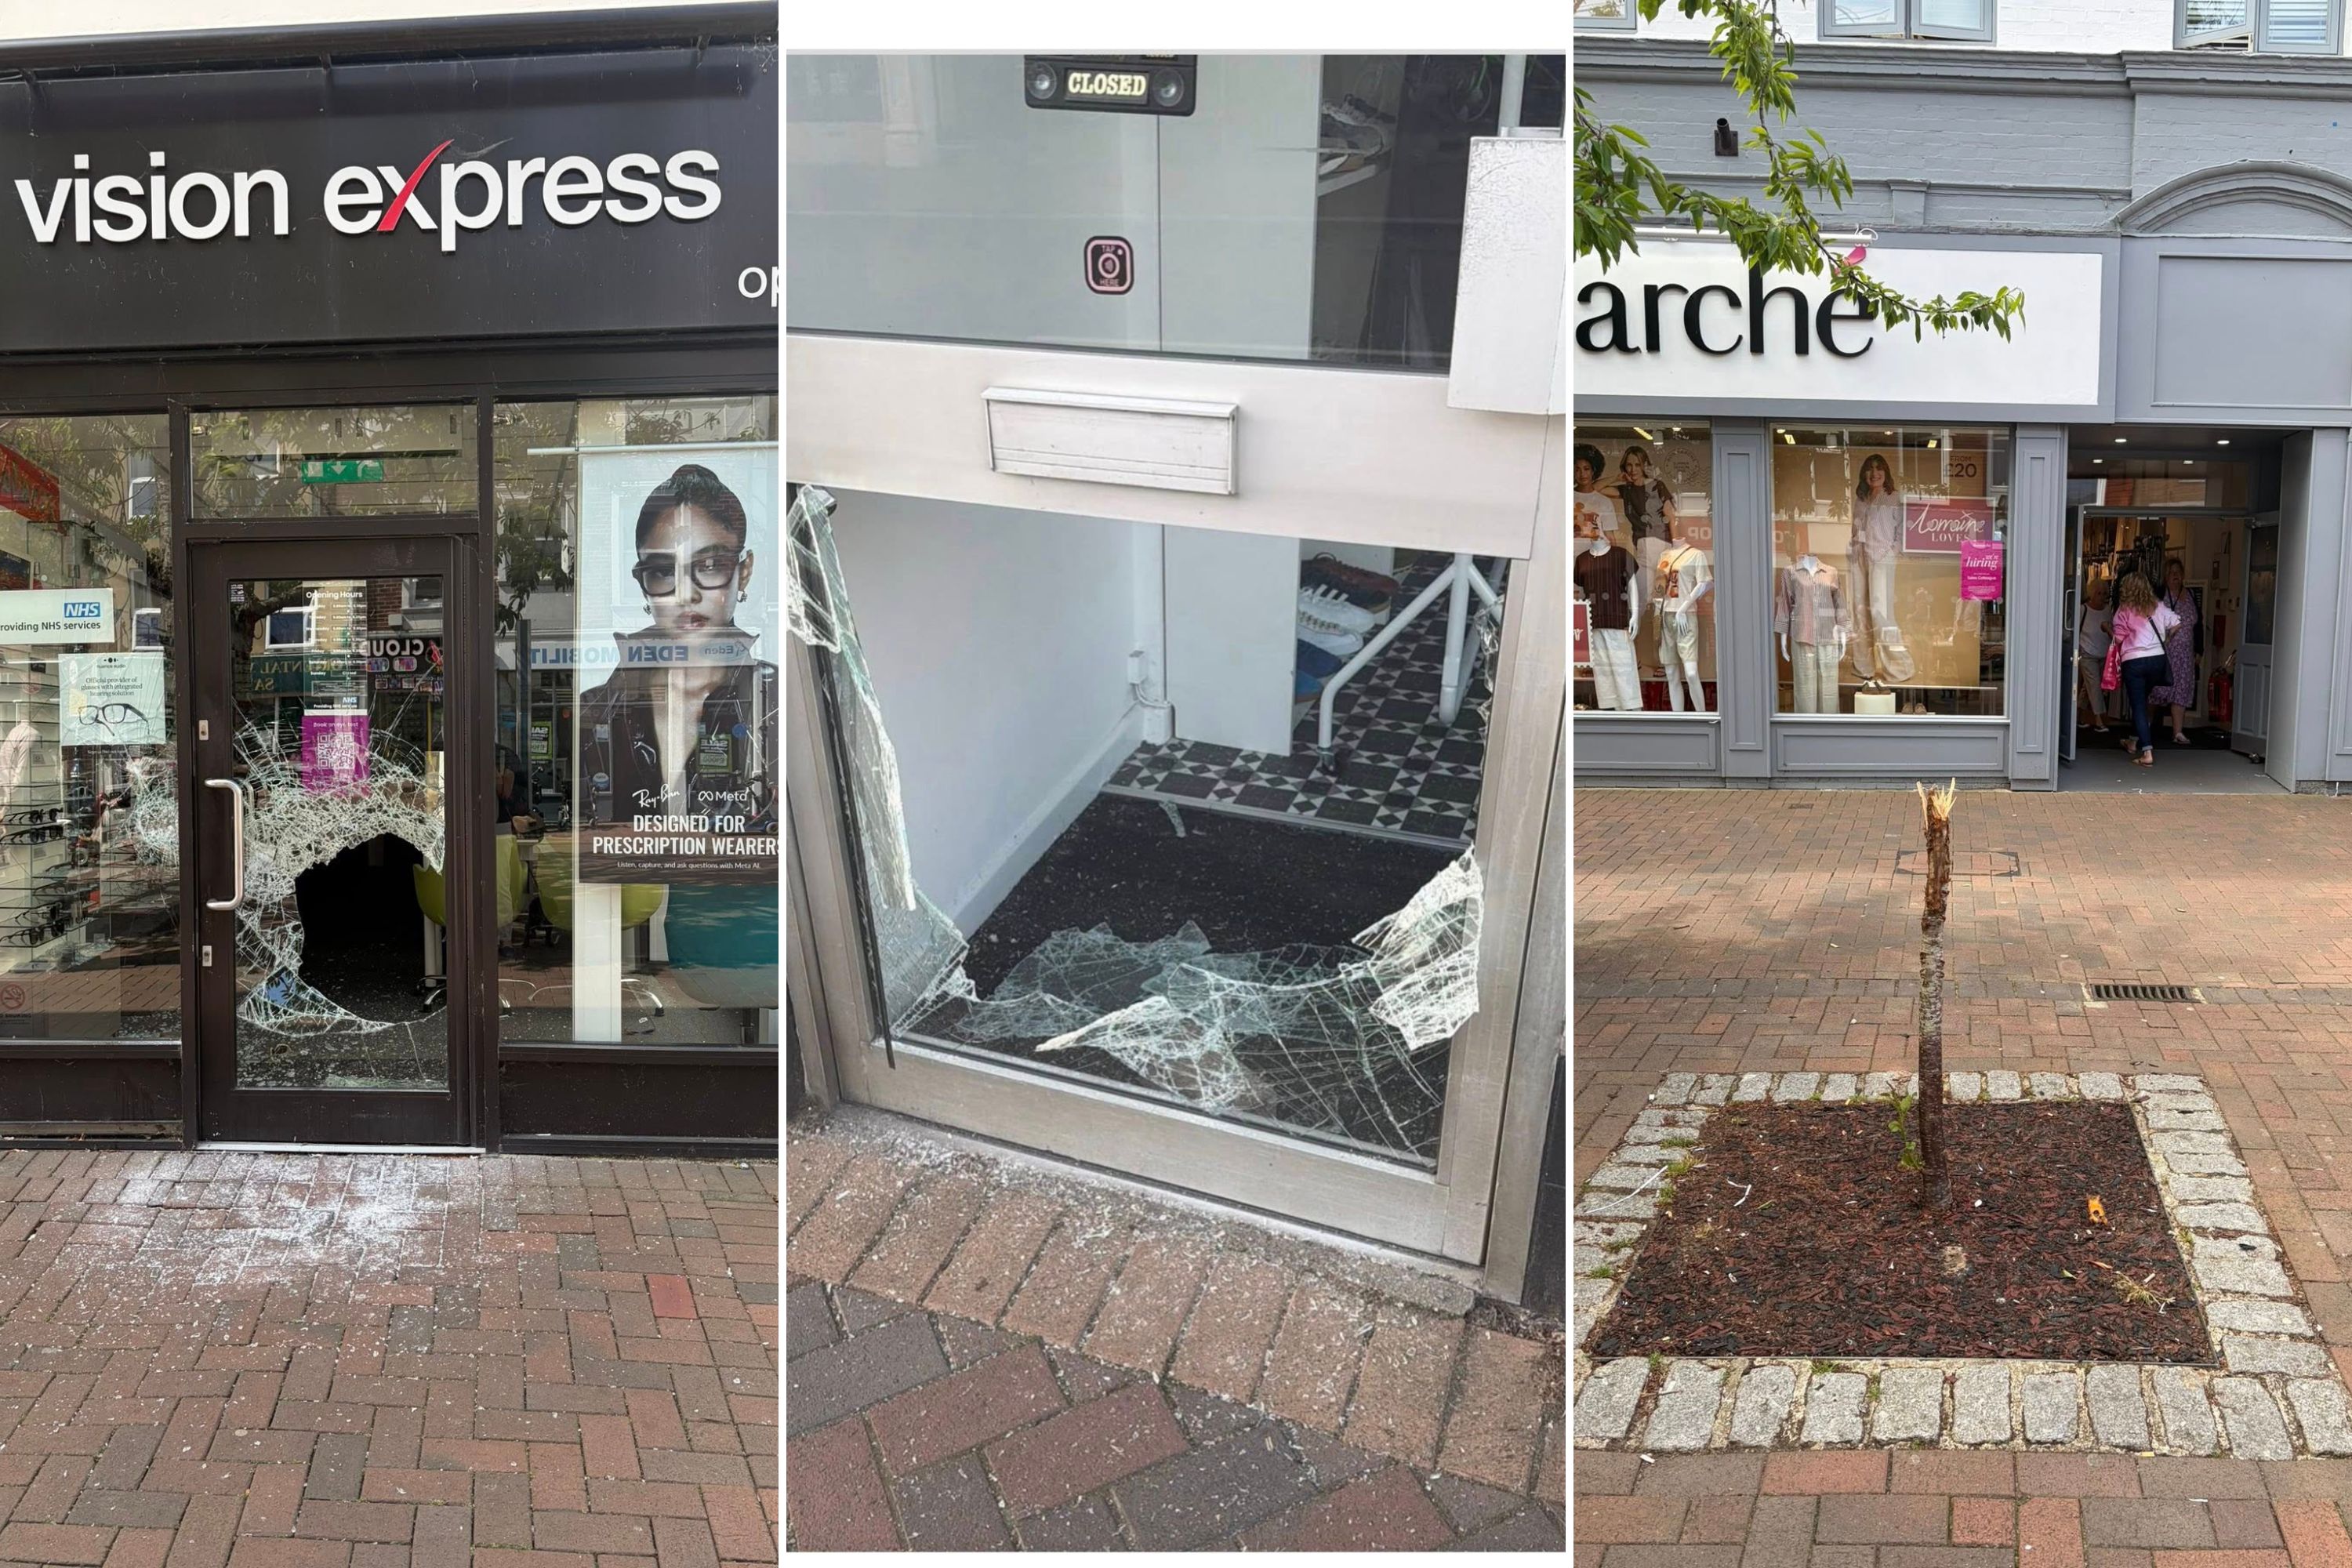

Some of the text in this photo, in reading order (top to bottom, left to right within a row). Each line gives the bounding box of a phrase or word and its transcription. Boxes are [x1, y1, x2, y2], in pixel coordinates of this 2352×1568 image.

[1068, 72, 1147, 96] CLOSED
[15, 140, 722, 252] vision express
[1100, 278, 1120, 287] HERE
[1944, 463, 1977, 477] £20
[1931, 533, 1971, 543] LOVES
[1965, 556, 1998, 571] hiring
[306, 591, 339, 601] Opening
[65, 603, 100, 617] NHS
[42, 622, 61, 630] NHS
[64, 620, 101, 630] services
[632, 783, 681, 808] Ray-Ban
[715, 790, 747, 801] Meta
[633, 815, 745, 833] DESIGNED FOR
[593, 837, 779, 855] PRESCRIPTION WEARER
